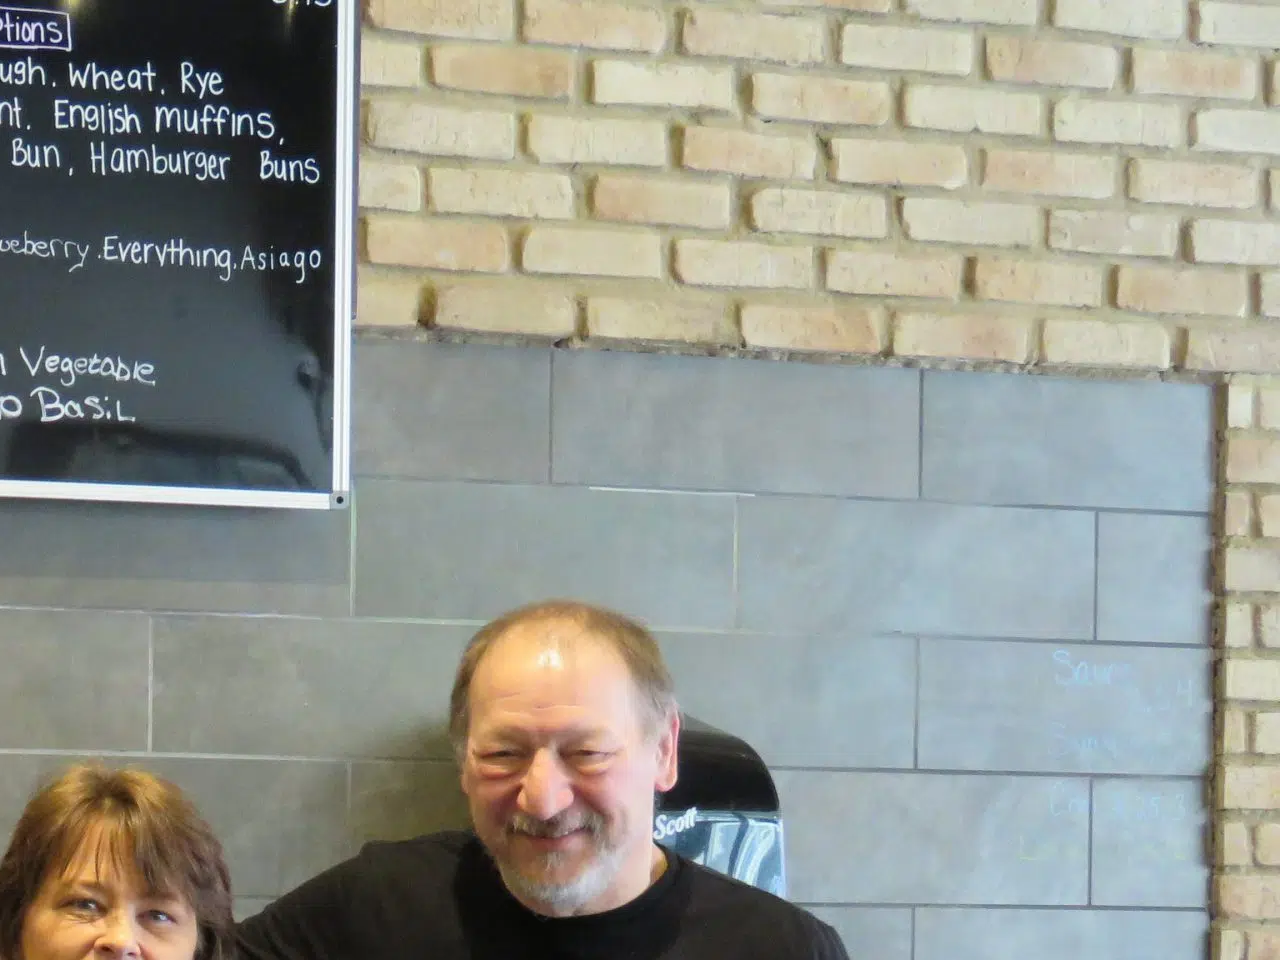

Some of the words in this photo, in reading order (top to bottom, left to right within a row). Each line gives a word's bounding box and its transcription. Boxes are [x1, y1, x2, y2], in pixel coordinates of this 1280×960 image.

[180, 60, 224, 100] Rye
[53, 98, 142, 136] English
[90, 141, 231, 181] Hamburger
[259, 149, 321, 185] Buns
[240, 244, 322, 284] Asiago
[19, 345, 156, 387] Vegetable
[653, 807, 697, 840] Scott
